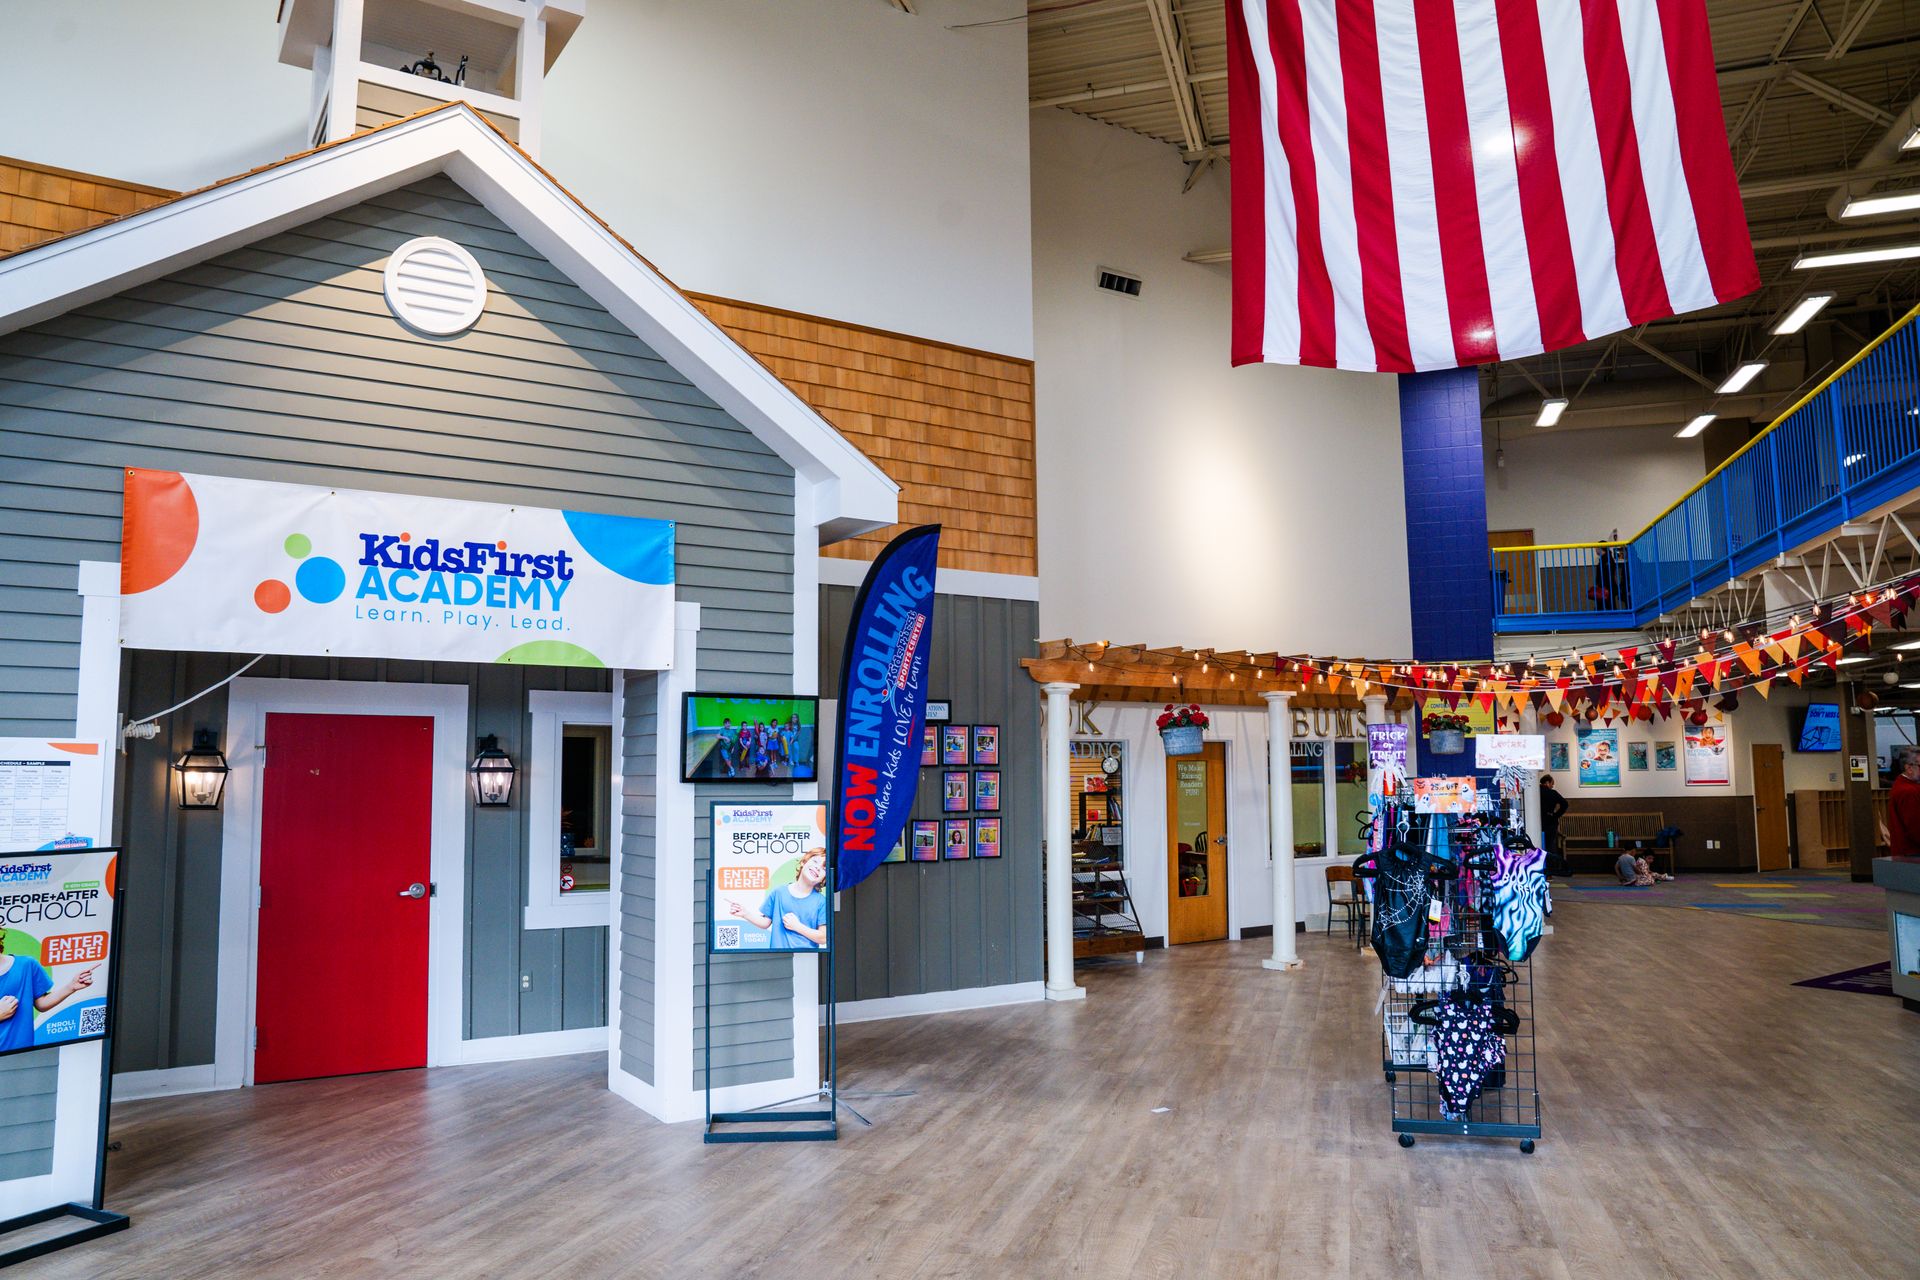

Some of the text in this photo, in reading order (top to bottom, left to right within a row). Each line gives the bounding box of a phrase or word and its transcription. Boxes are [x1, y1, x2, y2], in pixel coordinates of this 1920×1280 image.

[358, 532, 574, 581] KidsFirst
[355, 566, 571, 612] ACADEMY
[355, 604, 571, 631] Learn. Play. Lead.
[896, 615, 925, 689] SPORTS CENTER
[907, 655, 922, 689] Learn
[904, 691, 915, 703] to
[843, 566, 934, 851] NOW ENROLLING
[893, 704, 912, 746] LOVE
[1290, 707, 1367, 738] BUMS
[1371, 731, 1405, 741] TRICK
[1070, 742, 1122, 759] ADING
[1290, 742, 1323, 757] LING
[1382, 742, 1394, 750] or
[882, 749, 902, 779] Kids
[732, 809, 774, 817] KidsFirst
[732, 839, 808, 855] SCHOOL
[723, 869, 765, 879] ENTER
[1502, 872, 1528, 884] BOO
[723, 879, 765, 888] HERE!
[0, 889, 99, 906] EFORE+AFTER
[48, 934, 104, 951] ENTER
[48, 946, 102, 963] HERE!
[46, 1019, 76, 1029] ENROLL
[46, 1025, 76, 1034] TODAY!
